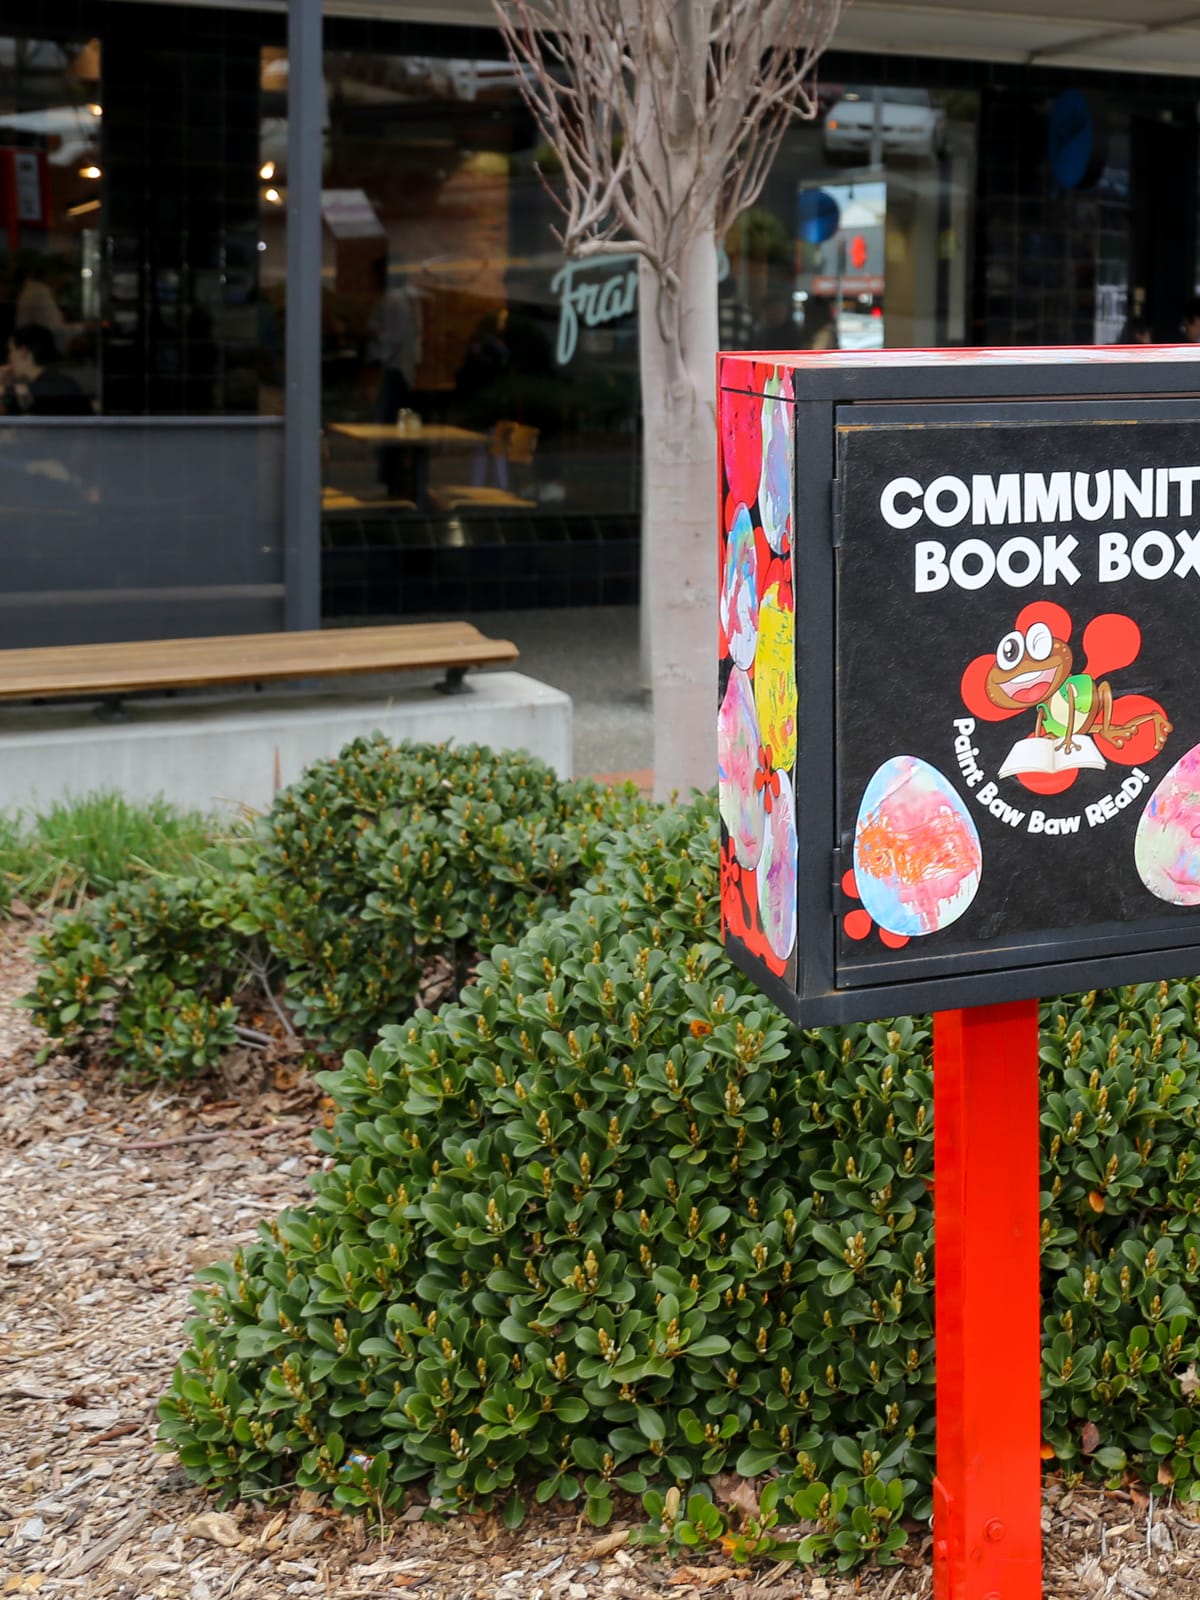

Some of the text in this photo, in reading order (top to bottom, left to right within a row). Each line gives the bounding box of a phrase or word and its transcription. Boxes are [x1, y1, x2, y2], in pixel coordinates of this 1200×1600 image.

[914, 533, 1082, 594] BOOK
[953, 717, 985, 788] Paint
[976, 781, 1026, 828] Baw
[1027, 809, 1081, 836] Baw
